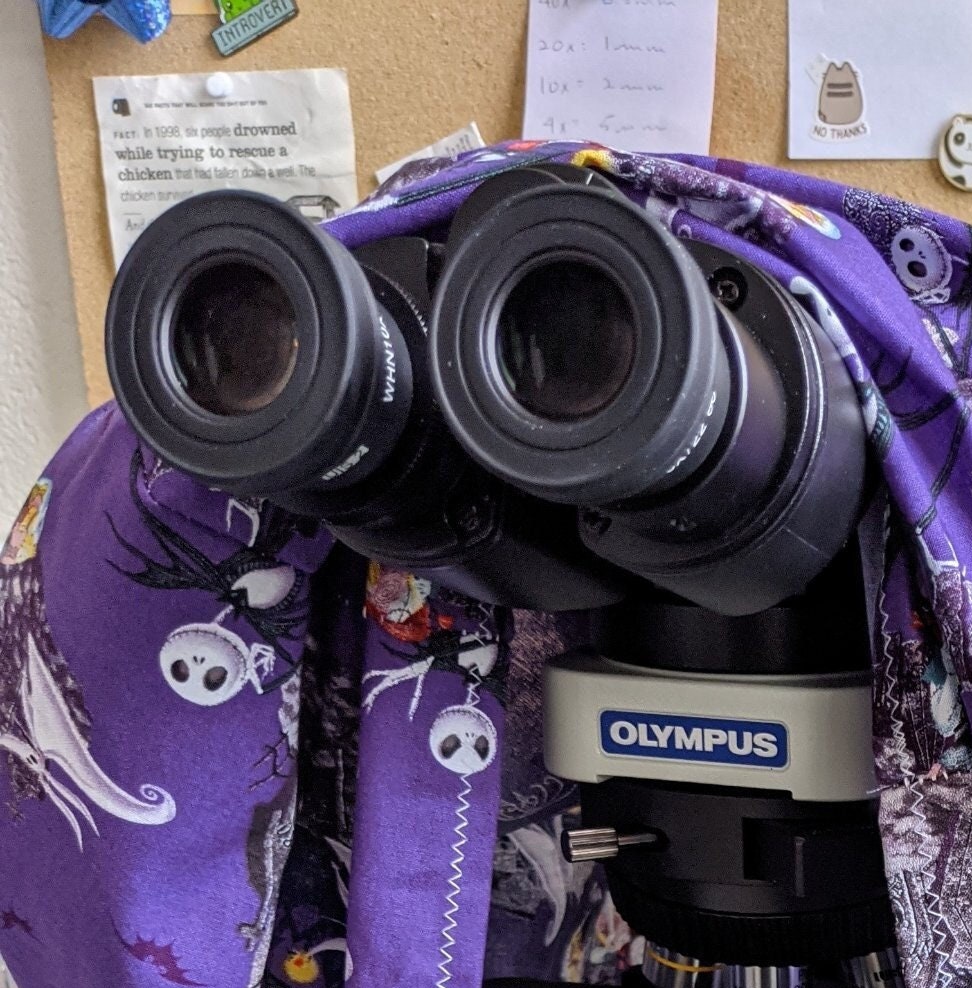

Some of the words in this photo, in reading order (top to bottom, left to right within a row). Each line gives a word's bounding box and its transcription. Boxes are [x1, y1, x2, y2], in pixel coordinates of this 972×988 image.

[217, 0, 288, 47] INTROVERT
[234, 122, 297, 137] drowned
[812, 126, 827, 137] NO
[830, 123, 868, 140] THANKS
[115, 147, 154, 161] while
[157, 145, 205, 162] trying
[210, 146, 225, 158] to
[229, 146, 275, 158] rescue
[280, 146, 288, 157] a
[118, 168, 173, 181] chicken
[298, 164, 316, 177] The
[120, 189, 156, 202] chicken
[609, 720, 778, 759] OLYMPUS
